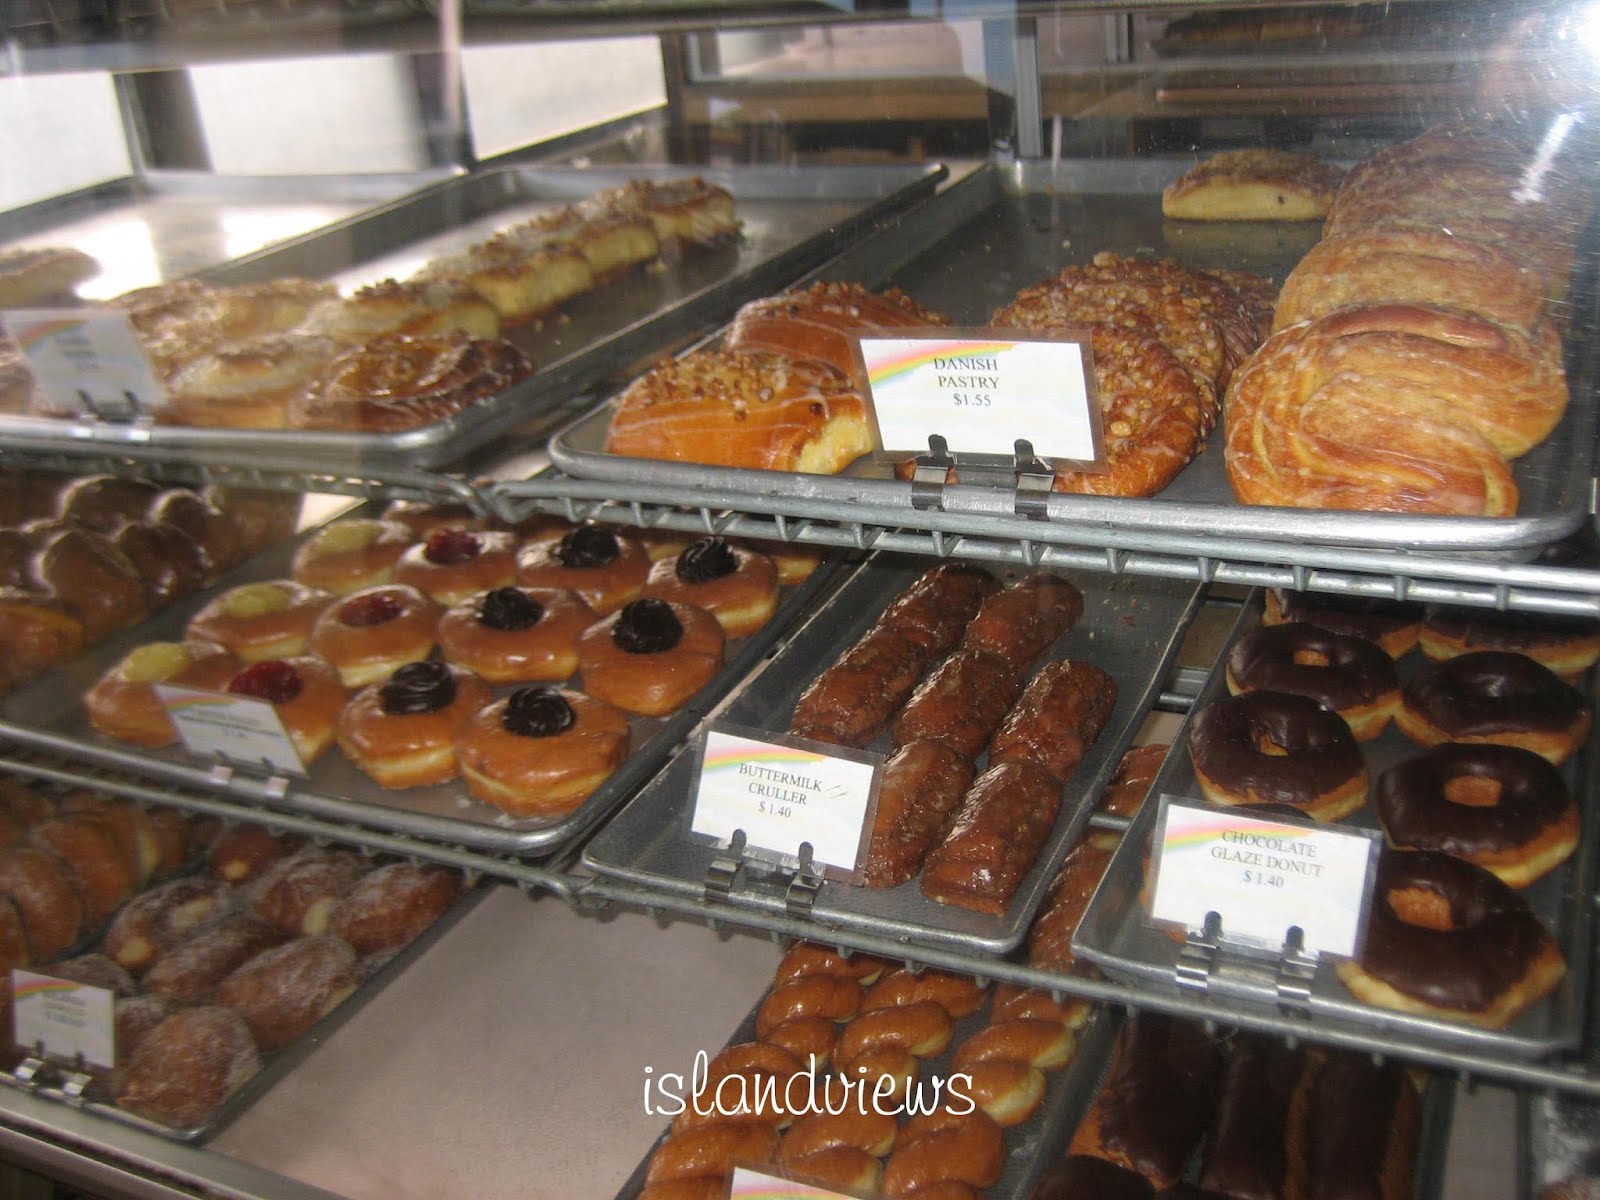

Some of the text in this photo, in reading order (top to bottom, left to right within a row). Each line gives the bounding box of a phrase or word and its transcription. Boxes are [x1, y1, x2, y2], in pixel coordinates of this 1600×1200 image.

[934, 358, 999, 371] DANISH
[938, 375, 1000, 389] PASTRY
[954, 393, 991, 407] $1.55
[739, 763, 823, 792] BUTTERMILK
[748, 782, 807, 805] CRULLER
[1222, 829, 1318, 858] CHOCOLATE
[1211, 846, 1324, 877] GLAZE DONUT
